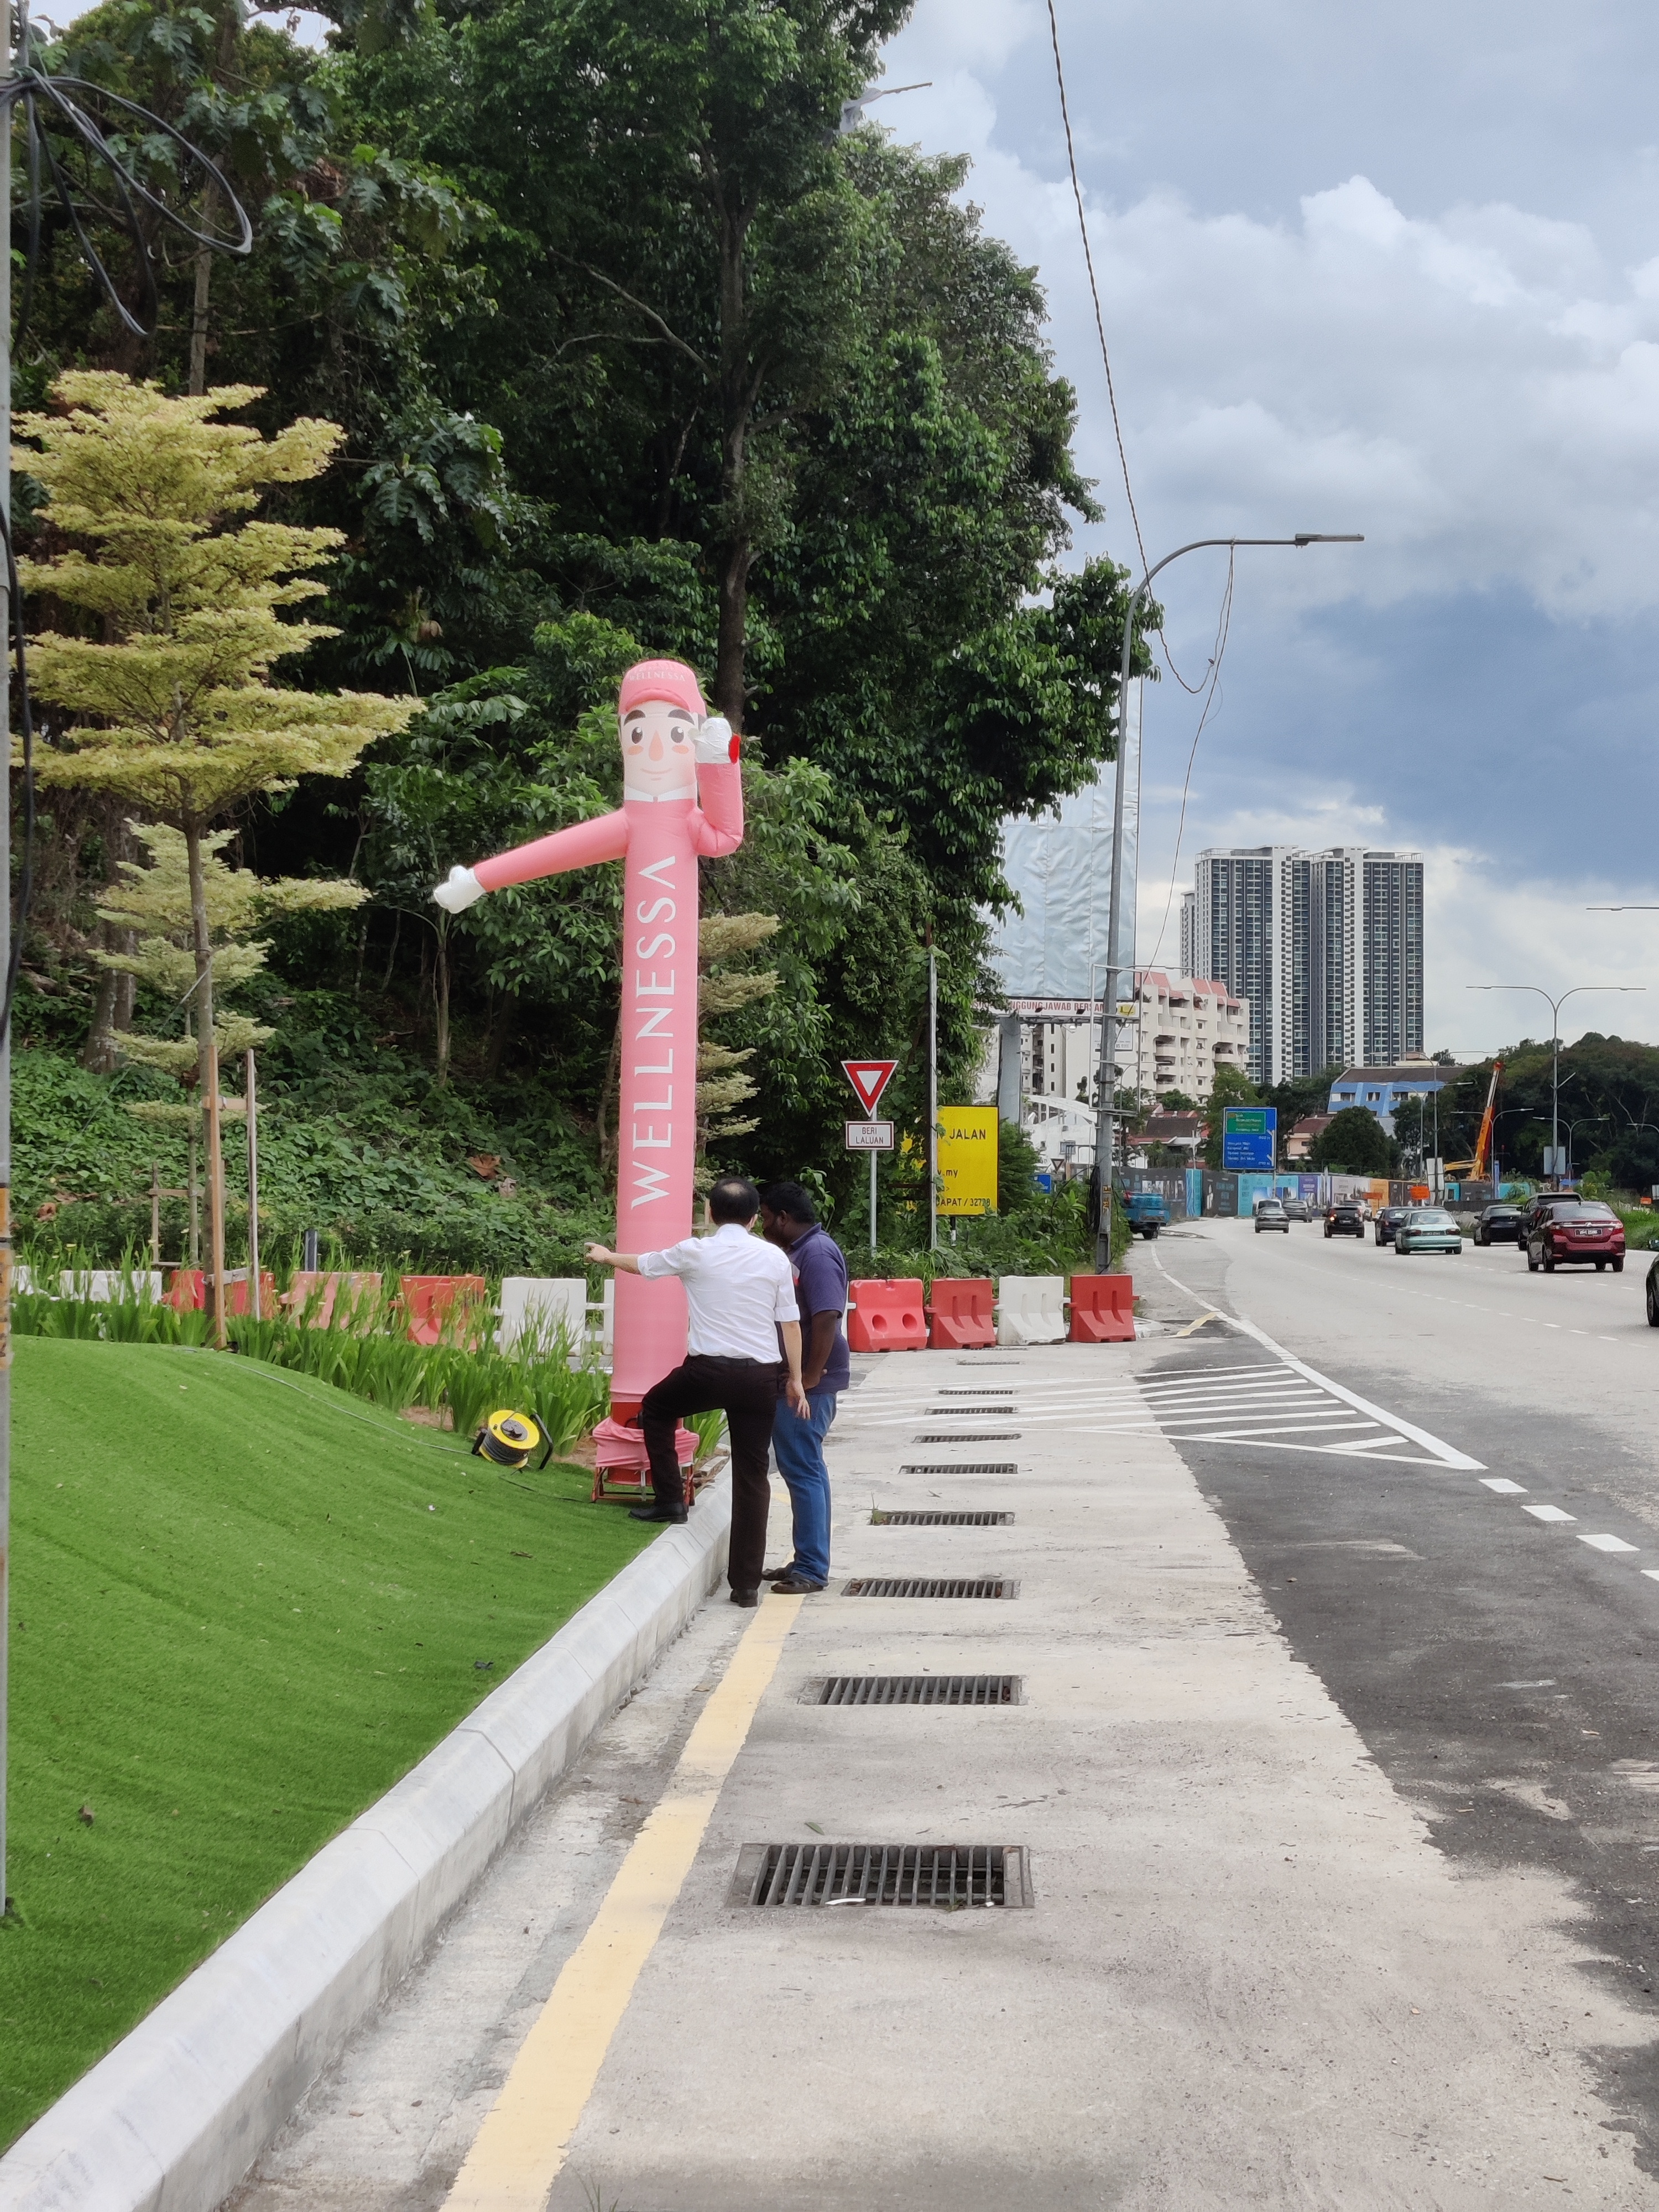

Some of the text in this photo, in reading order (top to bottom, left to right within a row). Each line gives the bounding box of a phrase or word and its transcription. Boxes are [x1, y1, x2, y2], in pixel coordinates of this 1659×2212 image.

[632, 855, 676, 1210] WELLNESSA
[855, 1136, 884, 1144] LALUAN
[949, 1128, 986, 1140] JALAN
